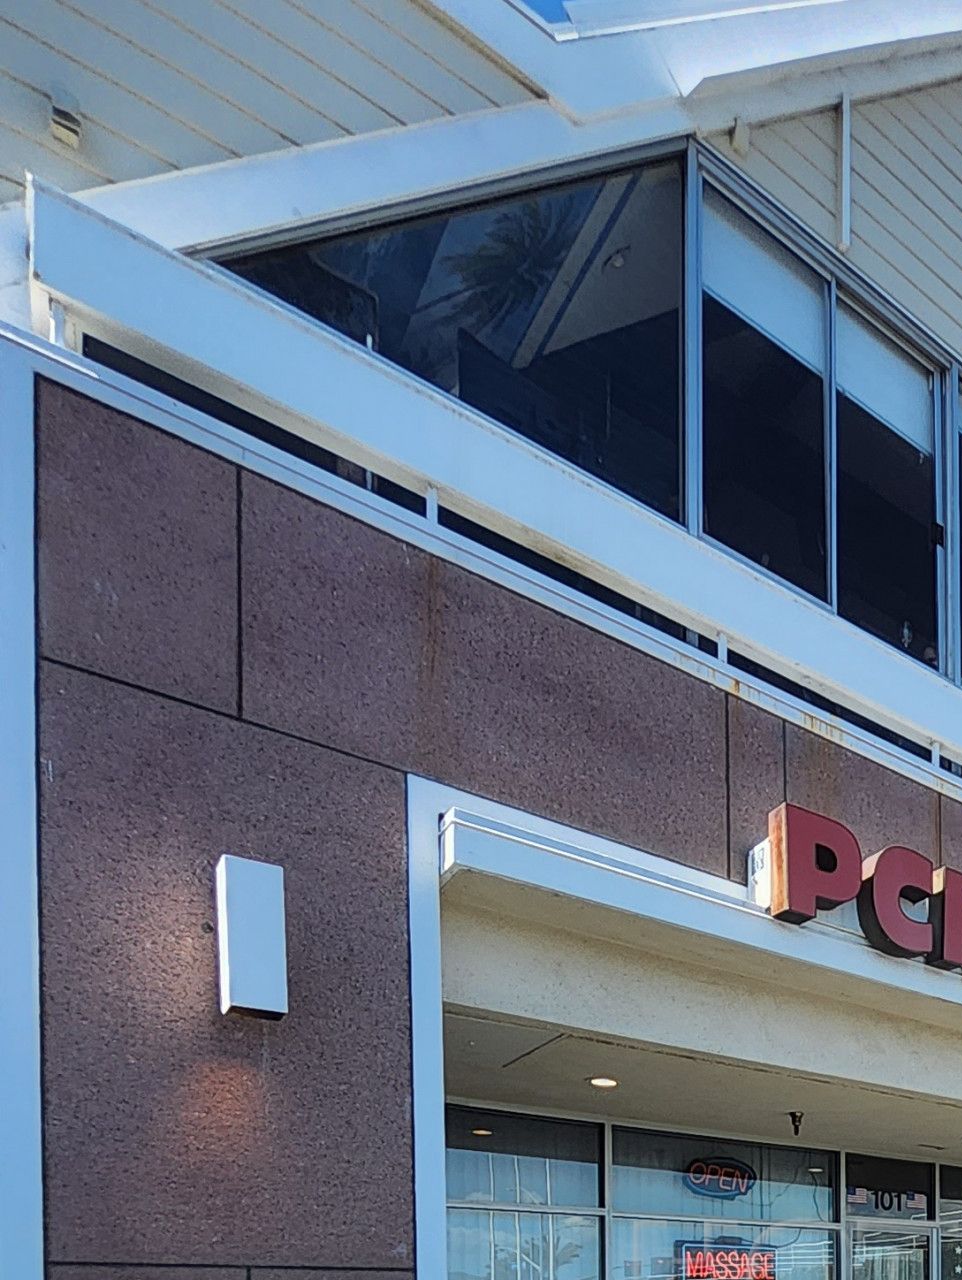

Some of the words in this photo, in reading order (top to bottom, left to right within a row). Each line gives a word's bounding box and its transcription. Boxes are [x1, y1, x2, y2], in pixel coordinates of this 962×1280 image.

[688, 1162, 750, 1193] OPEN
[870, 1191, 902, 1212] 101
[685, 1250, 775, 1280] MASSAGE
